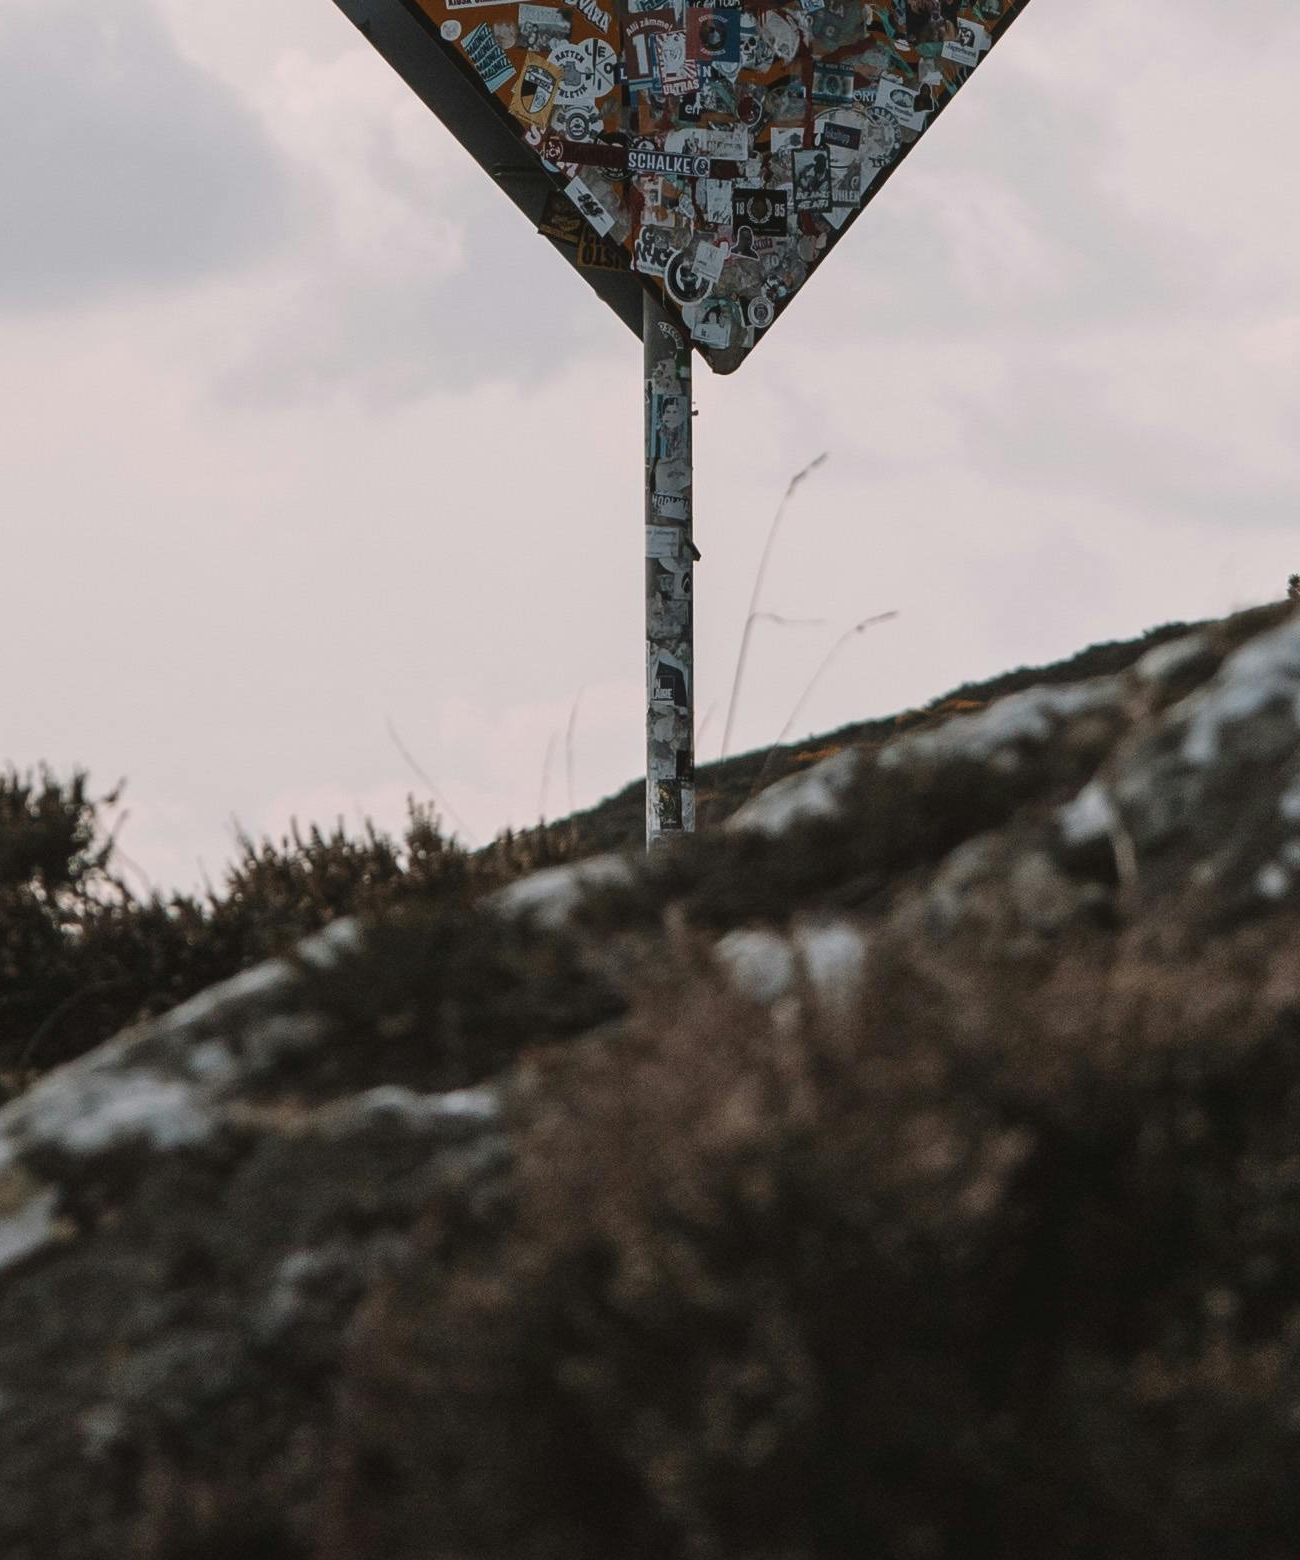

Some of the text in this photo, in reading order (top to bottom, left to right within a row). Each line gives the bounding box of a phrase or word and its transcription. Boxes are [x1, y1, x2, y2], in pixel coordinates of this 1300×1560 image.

[555, 50, 585, 63] RATTEN
[663, 80, 700, 95] ULTRAS
[628, 152, 692, 173] SCHALKE
[735, 201, 745, 215] 18
